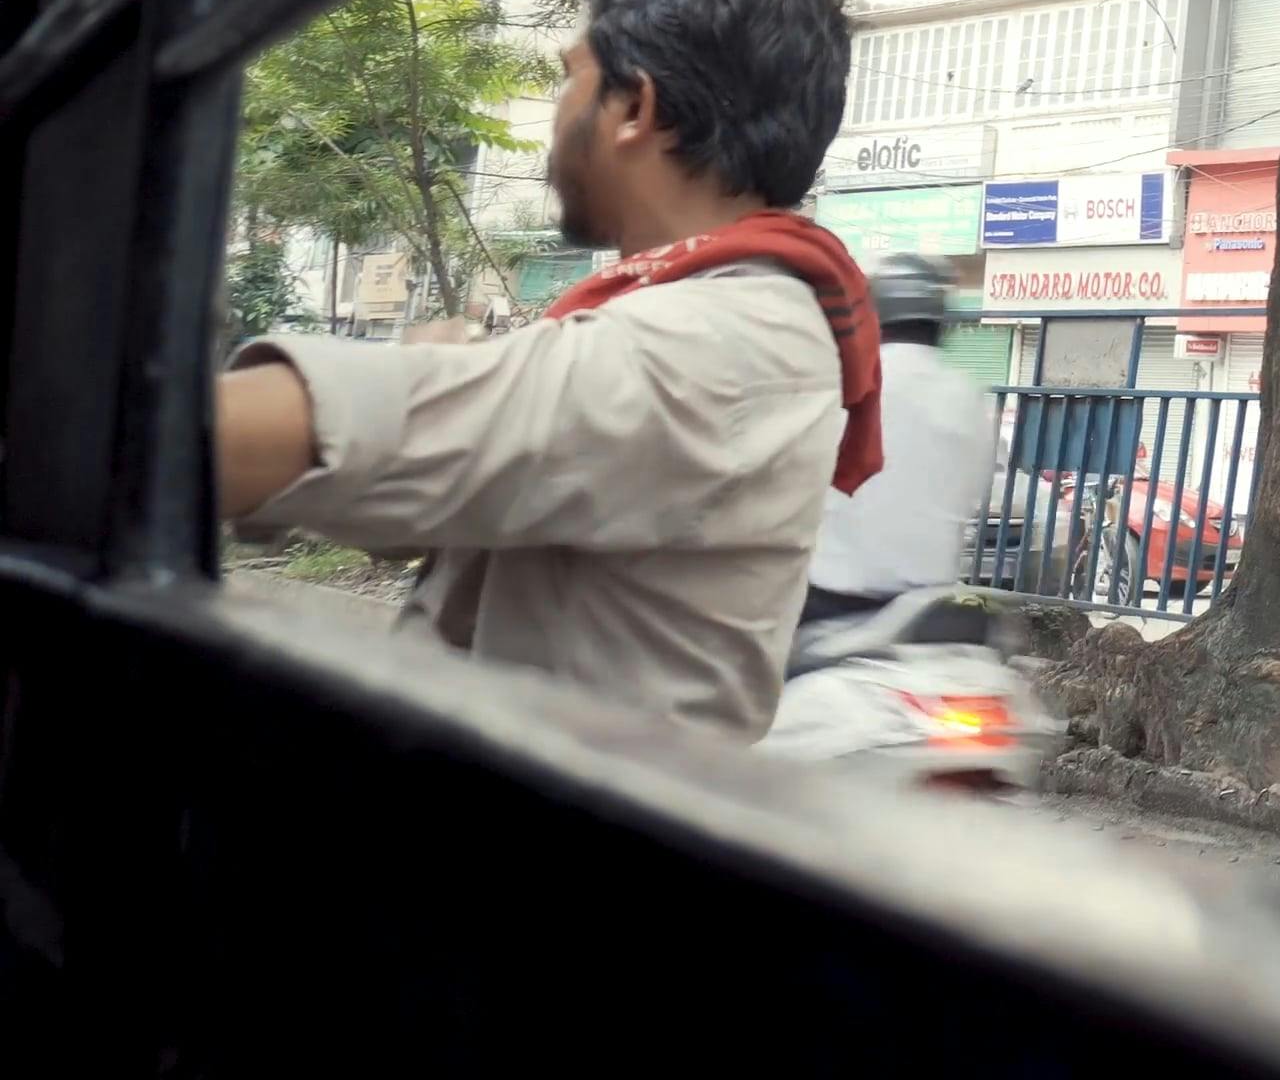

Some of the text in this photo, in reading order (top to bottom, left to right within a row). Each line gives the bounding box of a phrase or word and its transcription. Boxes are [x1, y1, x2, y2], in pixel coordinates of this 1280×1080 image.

[857, 134, 921, 171] elofic
[1086, 199, 1135, 220] BOSCH
[989, 271, 1074, 300] STANDARD
[1078, 272, 1133, 299] MOTOR
